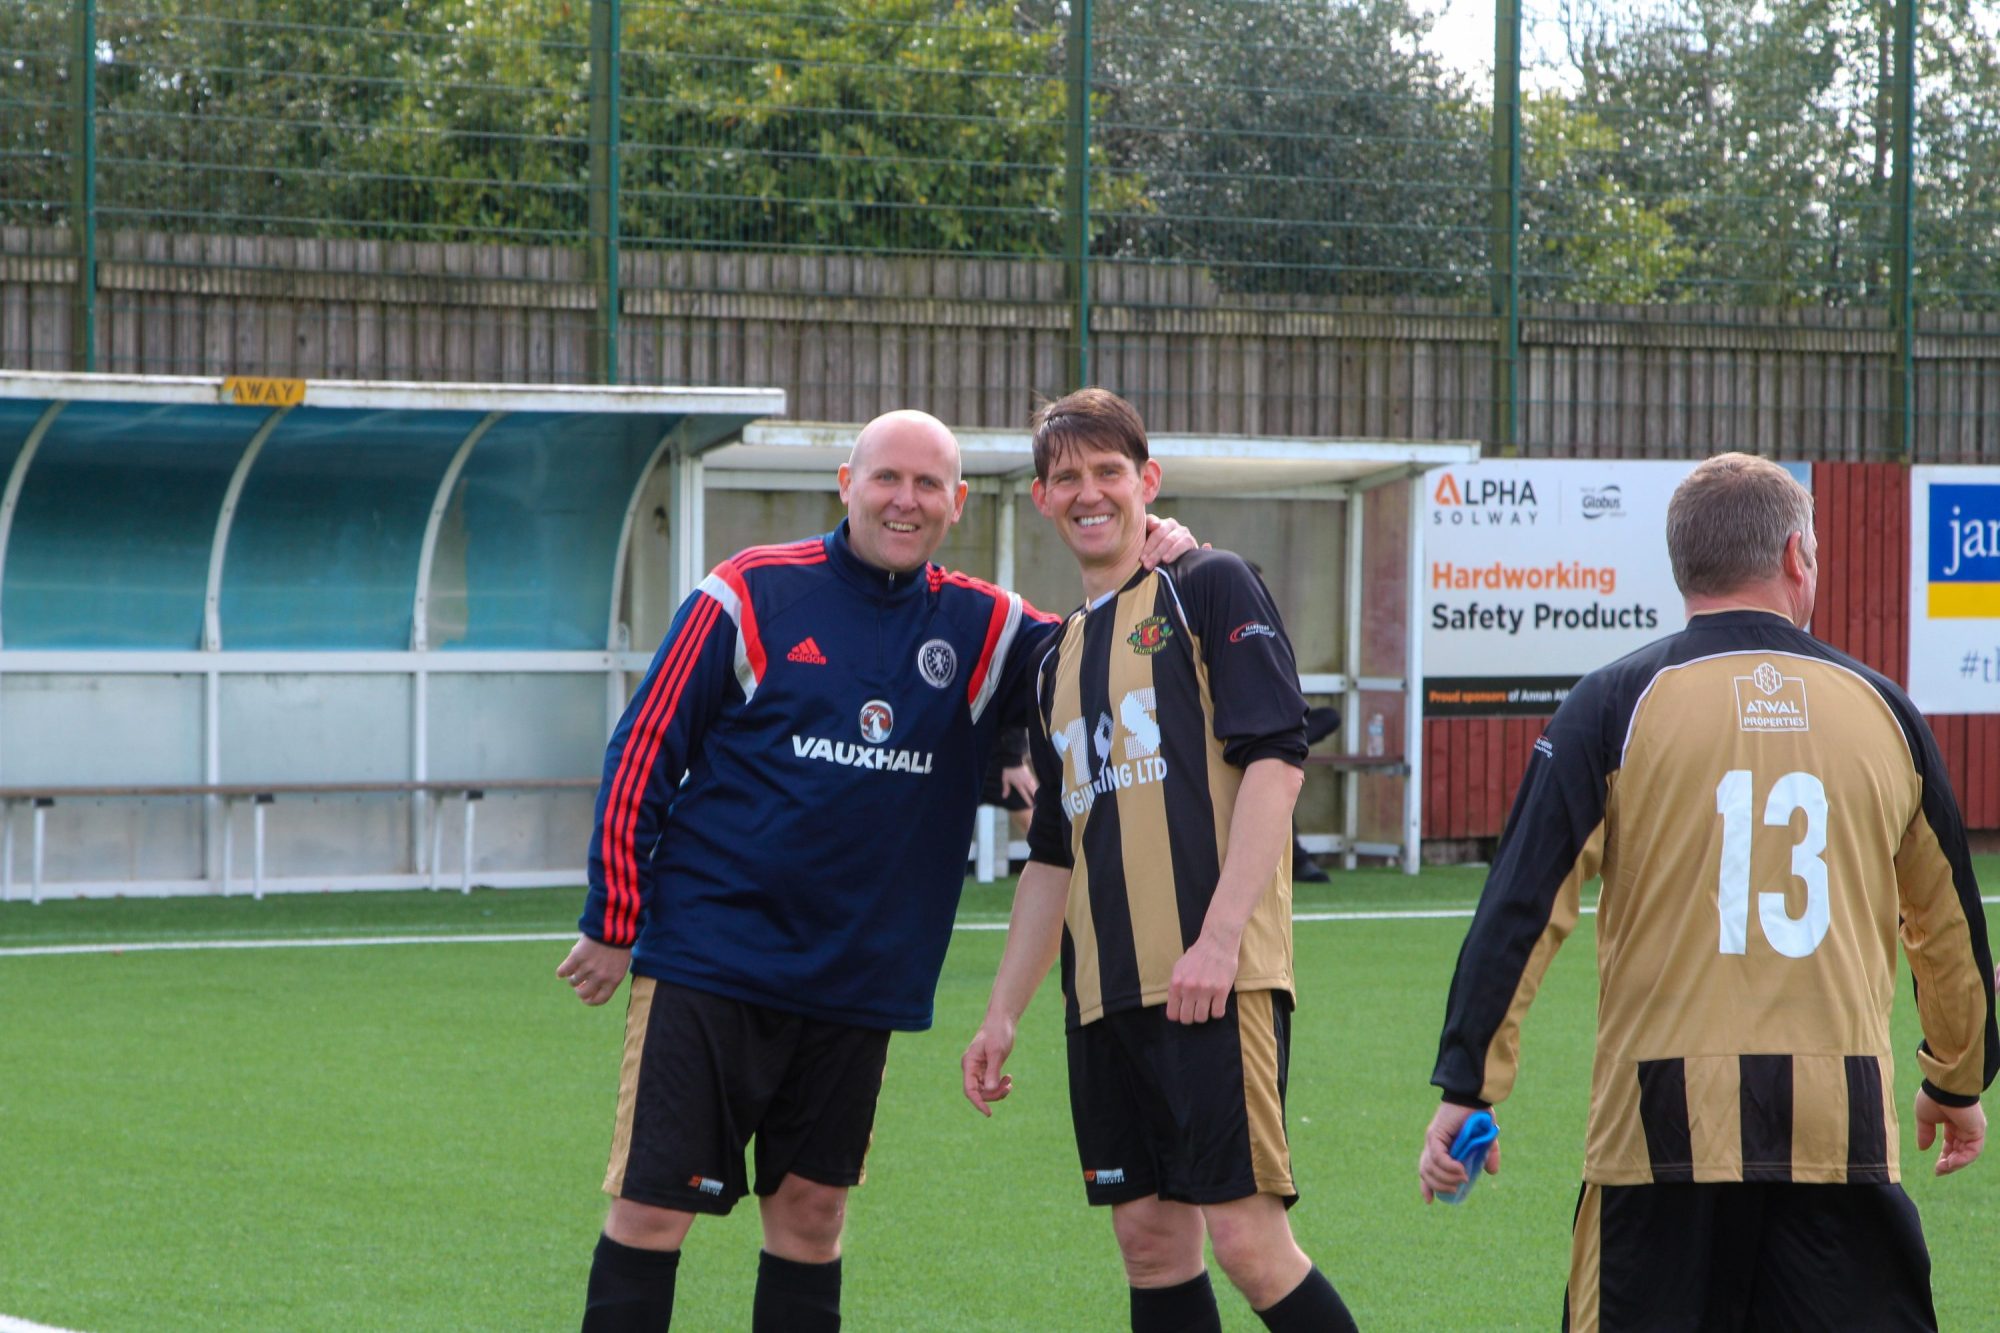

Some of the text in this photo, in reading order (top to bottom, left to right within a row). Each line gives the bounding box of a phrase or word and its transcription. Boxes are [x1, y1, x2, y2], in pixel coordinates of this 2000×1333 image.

[232, 381, 295, 401] AWAY
[1434, 473, 1537, 505] ALPHA
[1434, 511, 1537, 525] SOLWAY
[1432, 561, 1616, 594] Hardworking
[1432, 602, 1658, 635] Safety Products
[787, 651, 827, 665] adidas
[1508, 689, 1519, 702] of
[1746, 700, 1800, 713] ATWAL
[1743, 716, 1805, 726] PROPERTIES
[792, 735, 933, 774] VAUXHALL
[1136, 756, 1168, 785] LTD
[1716, 769, 1831, 958] 13
